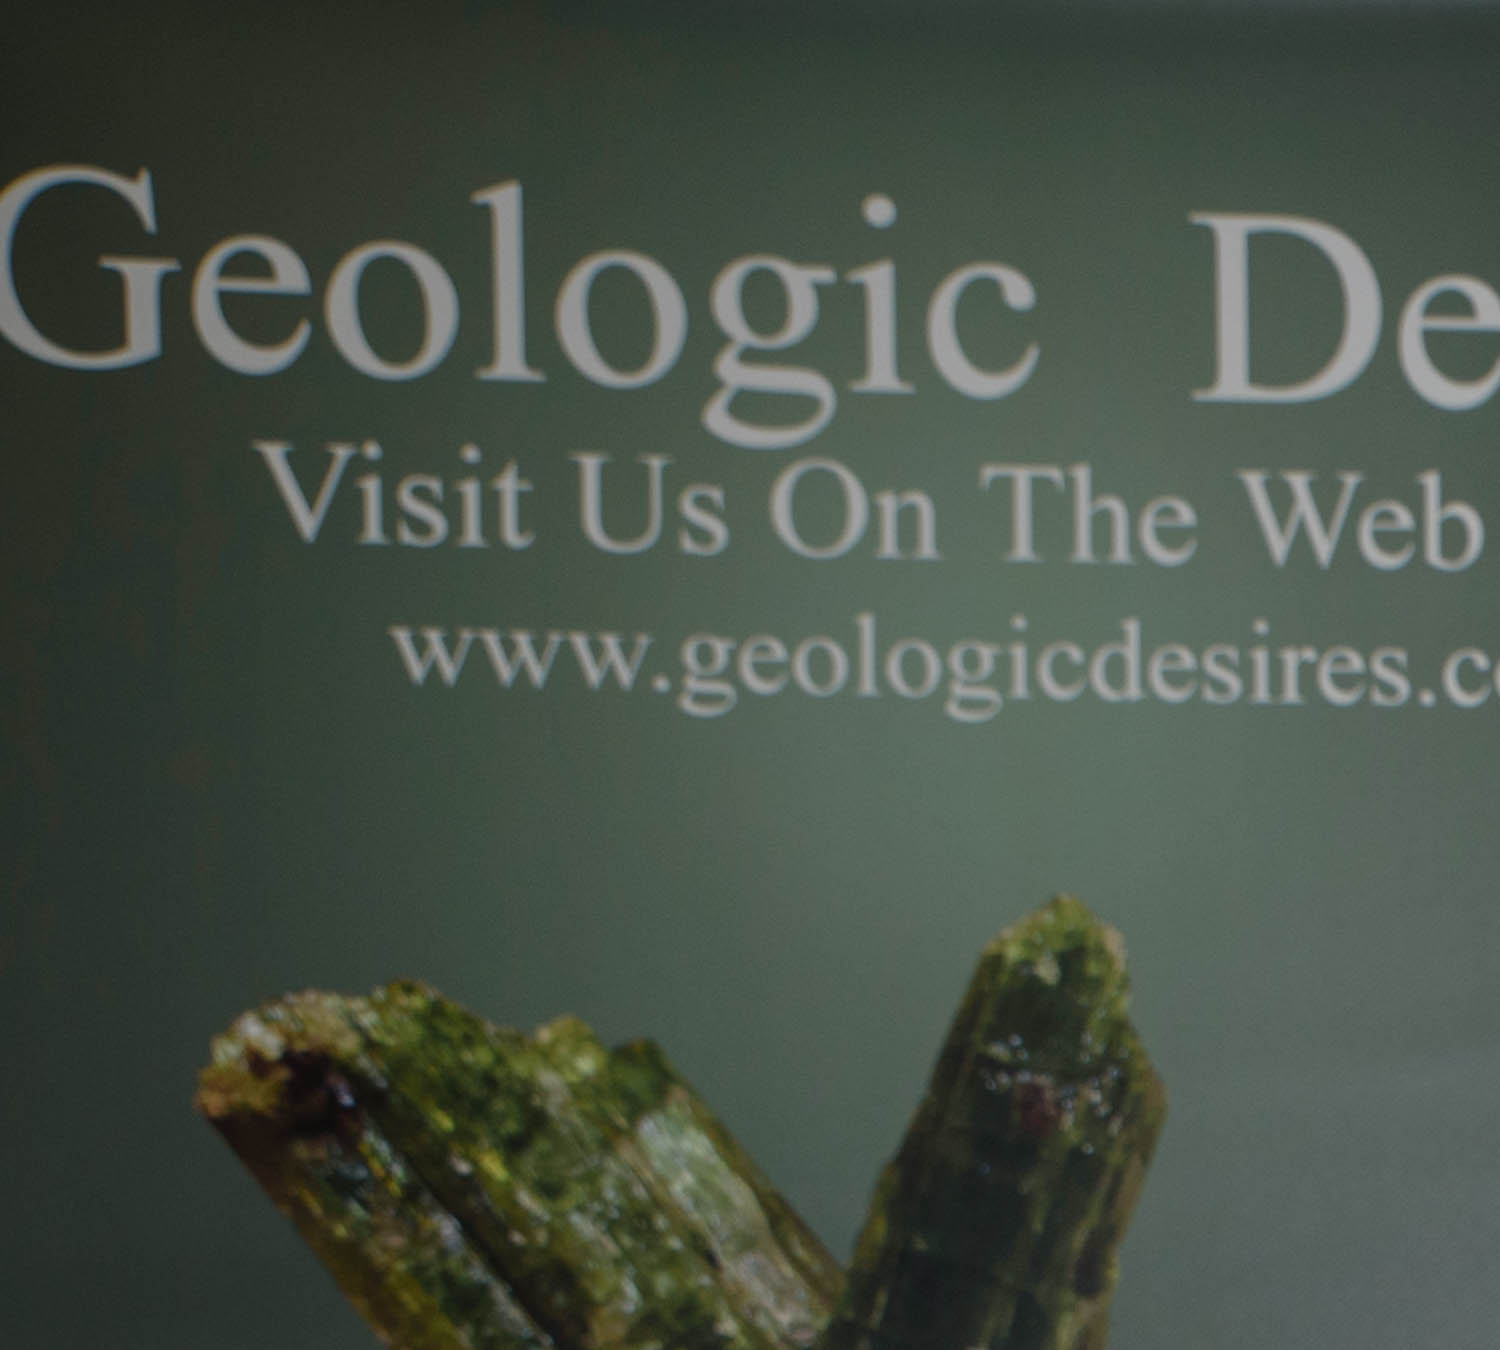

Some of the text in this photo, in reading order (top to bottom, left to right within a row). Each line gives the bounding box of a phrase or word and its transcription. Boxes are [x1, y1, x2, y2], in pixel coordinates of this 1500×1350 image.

[0, 163, 1040, 449] Geologic
[252, 438, 535, 550] Visit
[571, 451, 730, 557] Us
[769, 457, 939, 560] On
[979, 461, 1198, 567] The
[1237, 468, 1485, 572] Web
